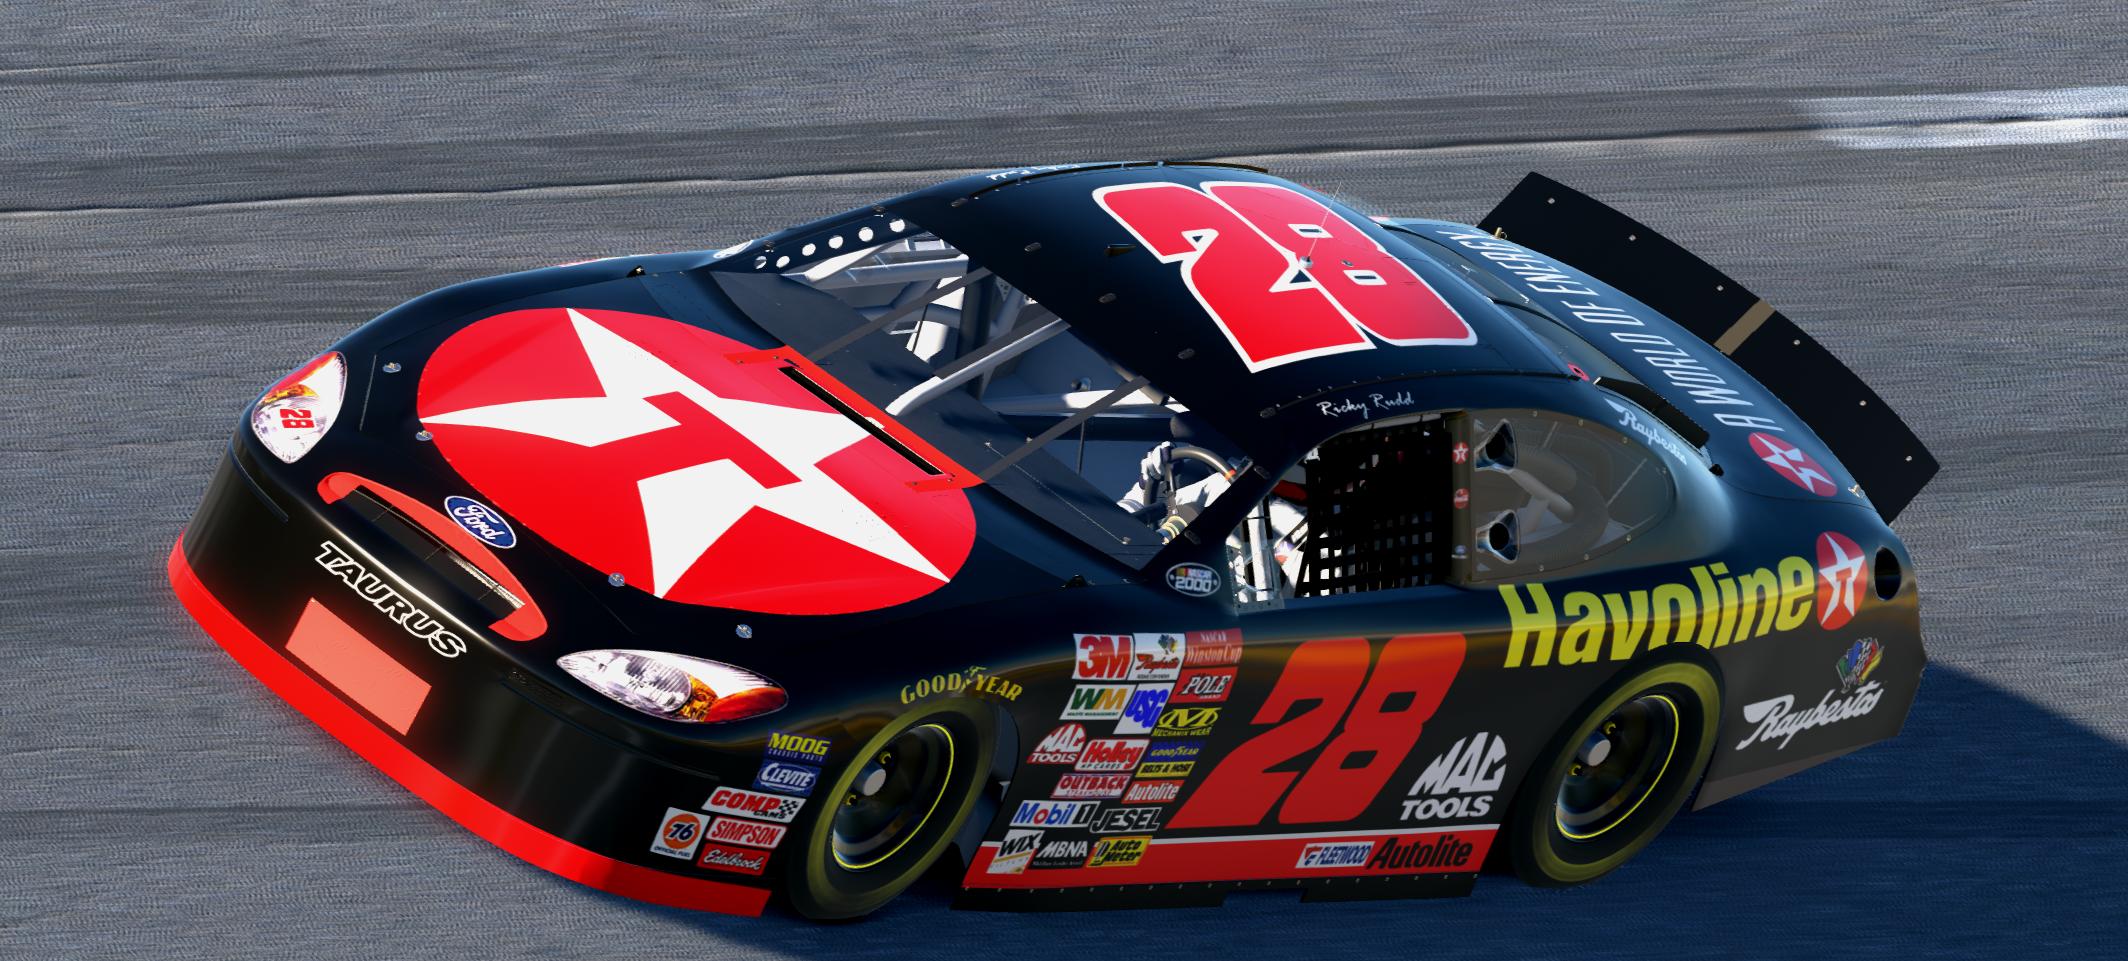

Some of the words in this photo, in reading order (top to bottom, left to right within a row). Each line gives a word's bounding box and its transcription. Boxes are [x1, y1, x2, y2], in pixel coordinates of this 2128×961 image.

[1435, 229, 1600, 296] ENERGY
[1092, 181, 1478, 373] 28
[1561, 300, 1645, 326] OF
[1610, 332, 1754, 406] WORLD
[1316, 399, 1370, 419] Ricky
[1368, 391, 1415, 410] Rudd
[280, 408, 315, 430] 28
[1603, 397, 1687, 465] Raybestos
[1713, 413, 1785, 432] A
[451, 502, 507, 543] Ford
[1175, 576, 1212, 592] 2000
[314, 540, 467, 658] TAURUS
[1498, 555, 1815, 668] Havoline
[1078, 635, 1131, 678] 3M
[1186, 645, 1224, 663] Winston
[1224, 643, 1243, 664] Cup
[1181, 675, 1232, 695] POLE
[1070, 688, 1128, 710] WM
[1125, 689, 1169, 728] USG
[1735, 679, 1888, 751] Raybestos
[1034, 724, 1086, 752] MAC
[1151, 727, 1188, 737] MECHANIX
[1189, 726, 1212, 737] WEAR
[1164, 632, 1467, 829] 28
[768, 732, 831, 756] MOOG
[1083, 741, 1145, 769] Holley
[1031, 752, 1078, 763] TOOLS
[1407, 732, 1507, 796] MAC
[760, 763, 814, 788] CLEVITE
[1060, 775, 1127, 790] OUTBACK
[711, 789, 782, 812] COMP
[1126, 782, 1181, 801] Autolite
[753, 811, 787, 820] CAMS
[1013, 802, 1077, 825] Mobil
[1089, 807, 1162, 834] JESEL
[1400, 796, 1494, 821] TOOLS
[669, 823, 695, 841] 76
[712, 820, 782, 848] SIMPSON
[1000, 832, 1041, 857] WIX
[1037, 841, 1088, 858] MBNA
[1106, 850, 1142, 862] Meter
[1111, 839, 1142, 851] Auto
[1316, 844, 1372, 865] FLEETWOOD
[1366, 835, 1473, 870] Autolite
[703, 849, 764, 870] Edelbrock
